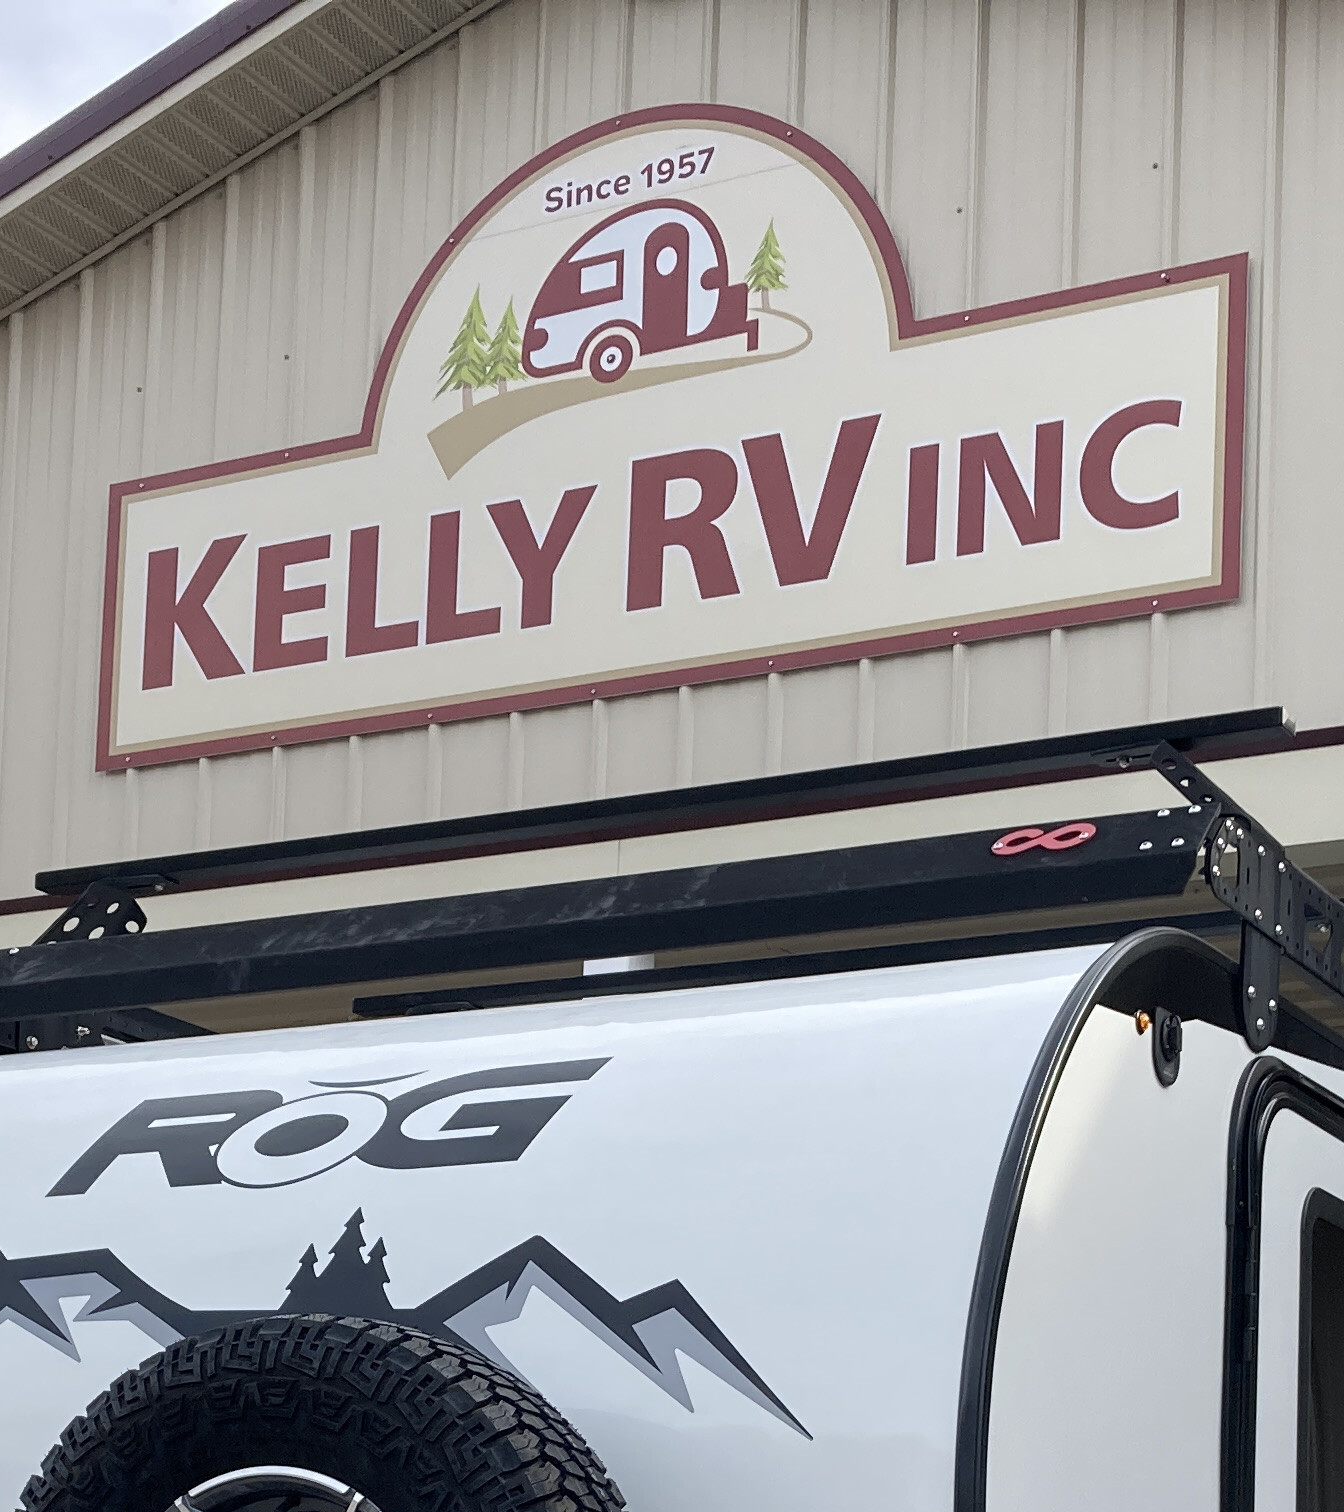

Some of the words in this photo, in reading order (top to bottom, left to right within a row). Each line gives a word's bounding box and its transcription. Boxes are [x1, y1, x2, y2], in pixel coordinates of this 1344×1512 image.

[544, 174, 631, 213] Since
[640, 146, 716, 189] 1957
[142, 486, 596, 690] KELLY
[626, 415, 882, 612] RV
[905, 399, 1183, 566] INC
